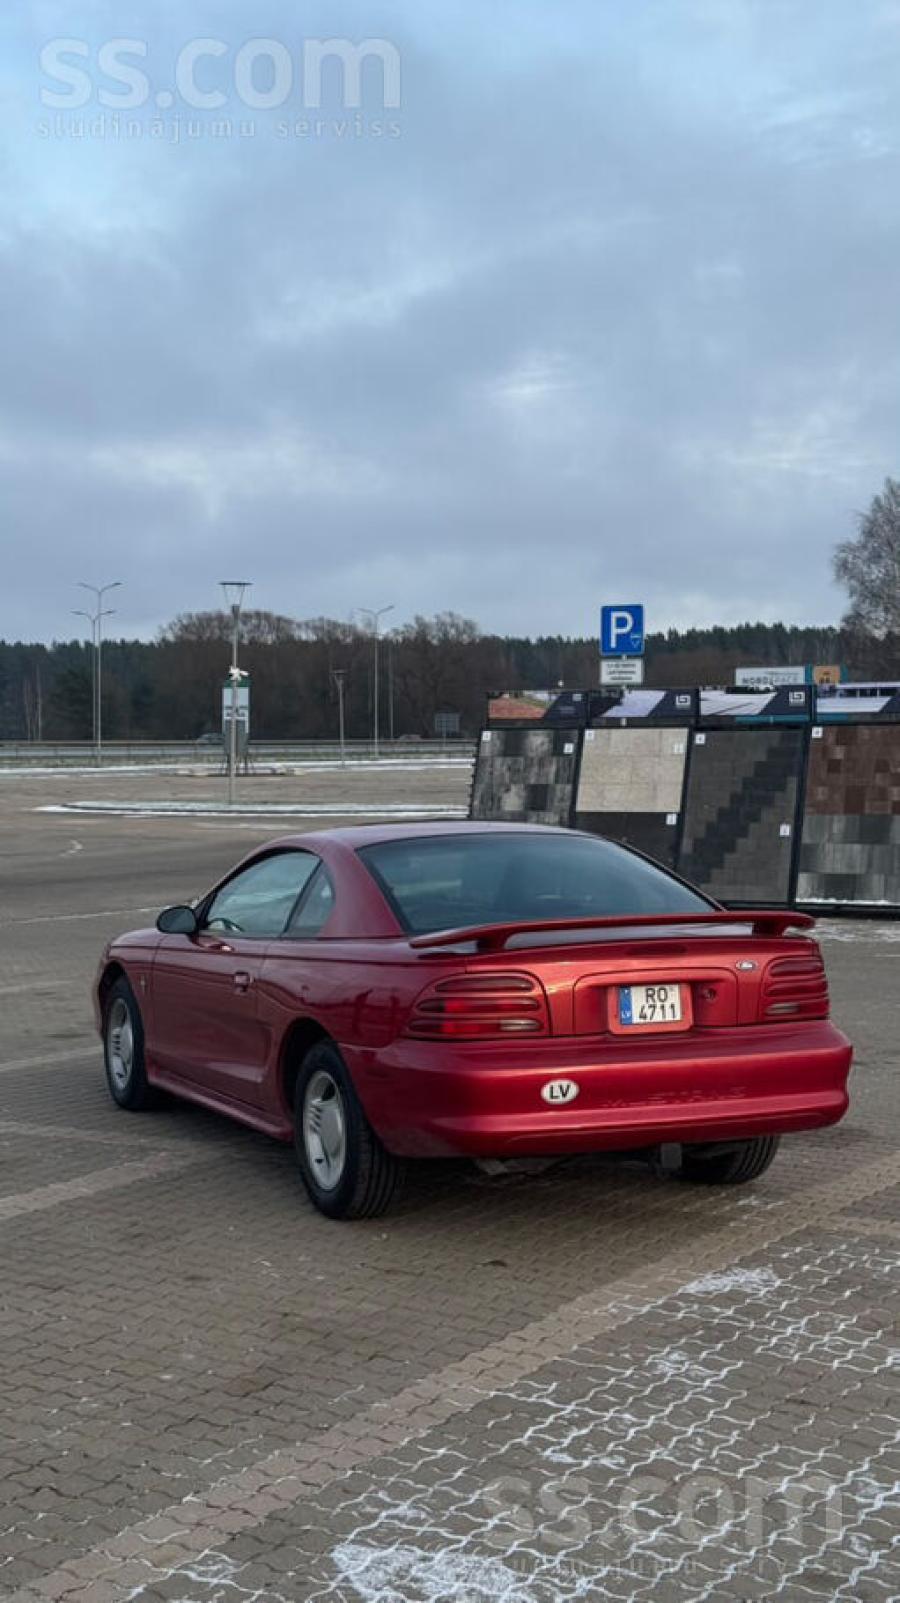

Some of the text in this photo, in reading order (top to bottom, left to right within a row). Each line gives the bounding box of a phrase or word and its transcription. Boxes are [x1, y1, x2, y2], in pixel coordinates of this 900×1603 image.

[610, 611, 634, 649] P
[645, 987, 668, 1004] RO
[638, 1003, 677, 1021] 4711
[549, 1084, 571, 1100] LV
